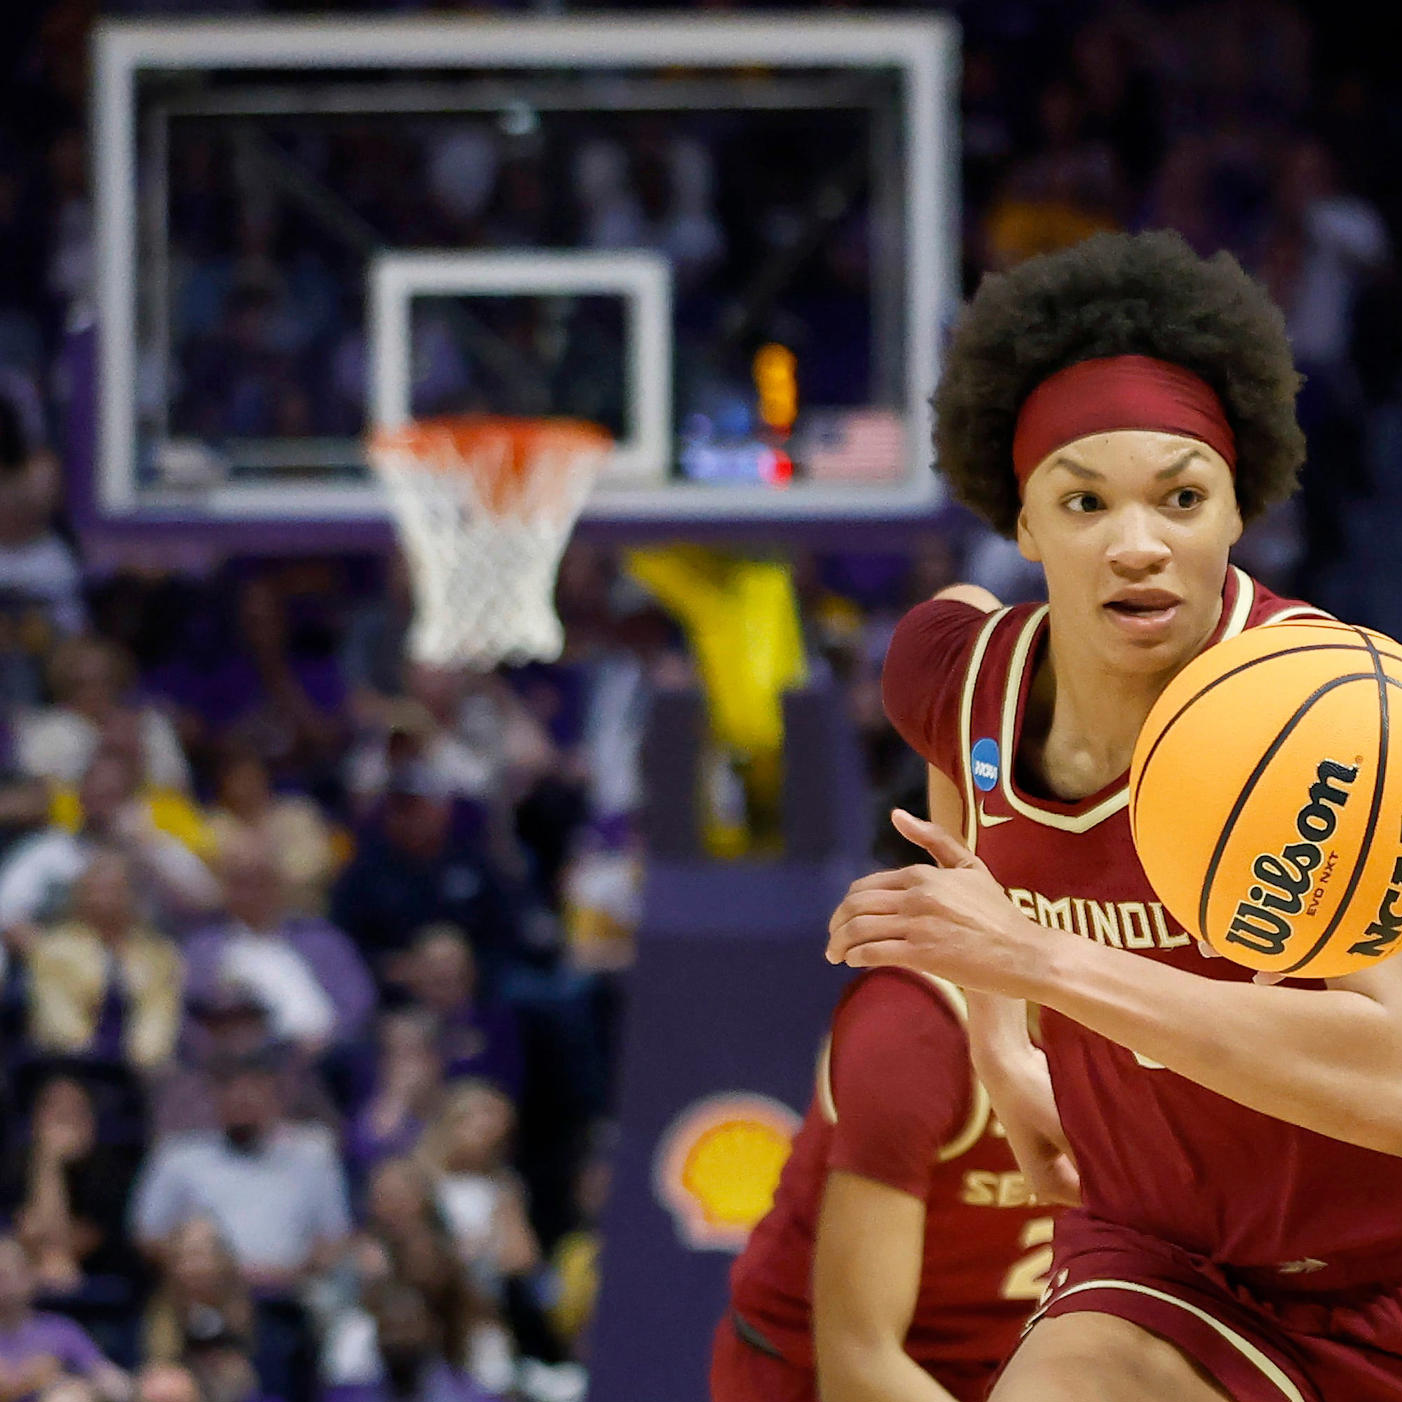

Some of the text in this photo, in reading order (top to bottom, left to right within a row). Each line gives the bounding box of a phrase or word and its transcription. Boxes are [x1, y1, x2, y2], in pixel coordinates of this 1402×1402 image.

[1224, 757, 1360, 956] Wilson
[1306, 850, 1339, 917] EVO NXT
[1007, 887, 1192, 950] EMINOL
